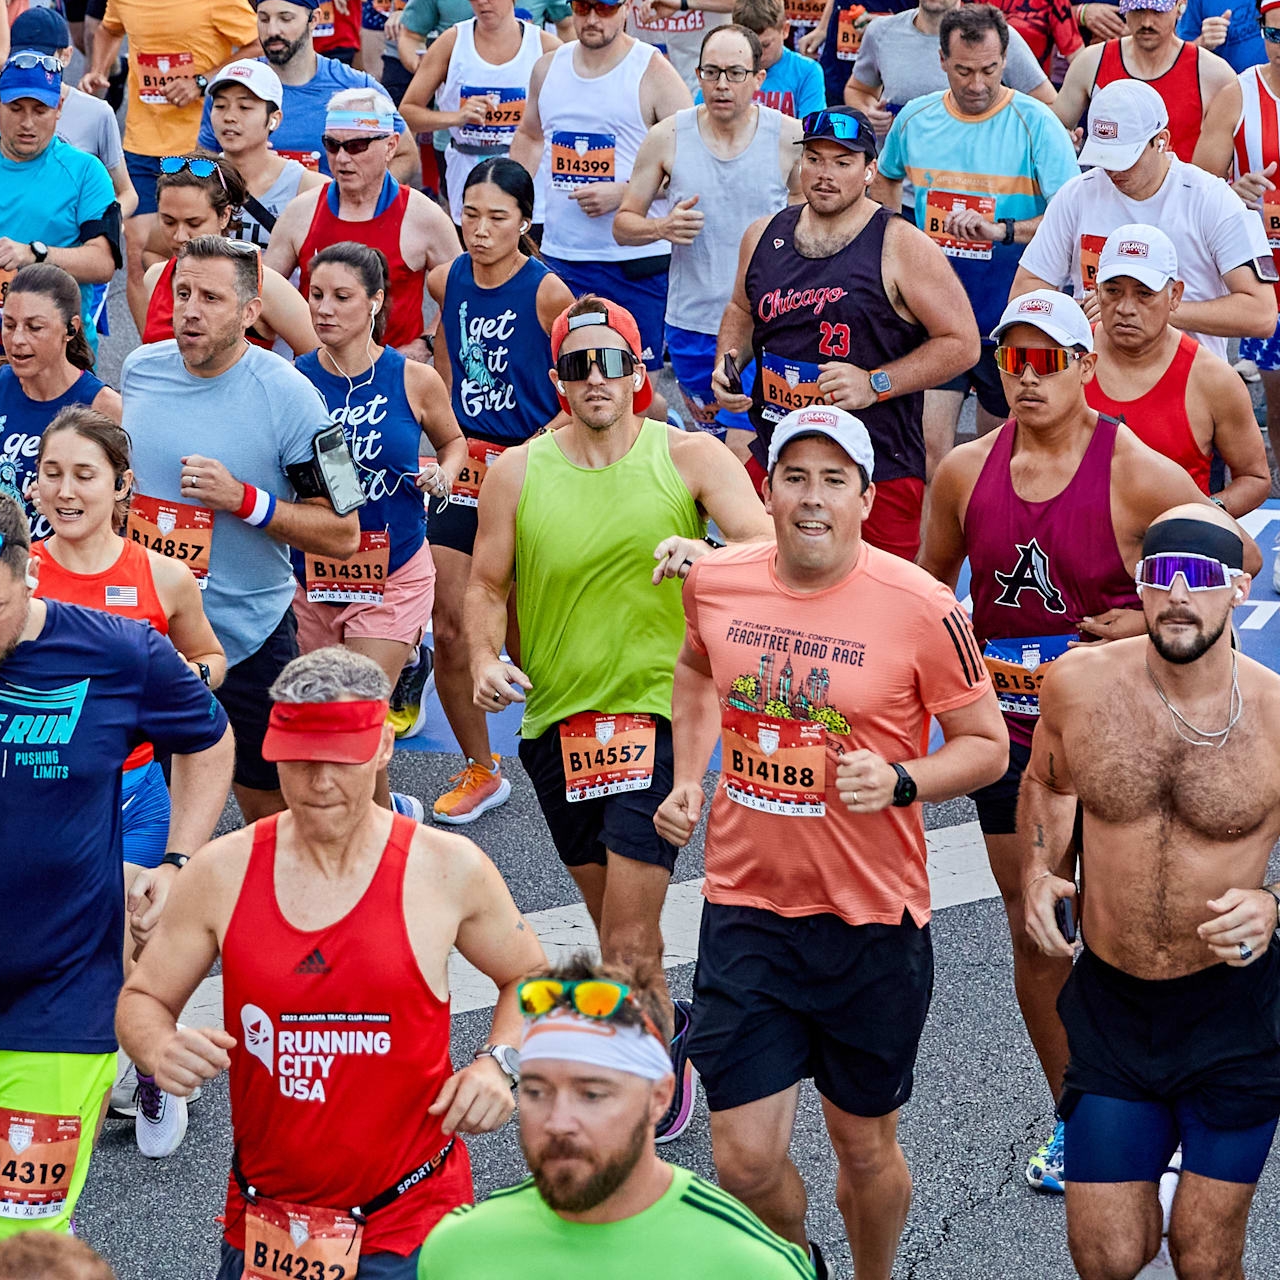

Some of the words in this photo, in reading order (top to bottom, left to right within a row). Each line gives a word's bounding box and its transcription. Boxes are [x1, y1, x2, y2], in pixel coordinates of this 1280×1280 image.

[666, 10, 704, 31] RACE
[484, 108, 522, 122] 4975
[555, 157, 611, 173] B14399
[757, 285, 850, 323] Chicago
[468, 309, 517, 342] get
[819, 321, 851, 357] 23
[487, 345, 509, 374] it
[461, 379, 517, 417] Girl
[331, 395, 388, 437] get
[4, 432, 40, 465] ge
[132, 528, 204, 560] B14857
[314, 560, 383, 580] B14313
[742, 621, 771, 632] ATLANTA
[726, 627, 789, 653] PEACHTREE
[794, 635, 827, 661] ROAD
[832, 642, 865, 667] RACE
[2, 713, 76, 745] RUN
[15, 750, 59, 766] PUSHING
[33, 763, 69, 780] LIMITS
[570, 744, 657, 772] B14557
[732, 749, 814, 788] B14188
[278, 1030, 391, 1056] RUNNING
[278, 1054, 334, 1080] CITY
[279, 1078, 326, 1103] USA
[396, 1160, 432, 1195] SPORT
